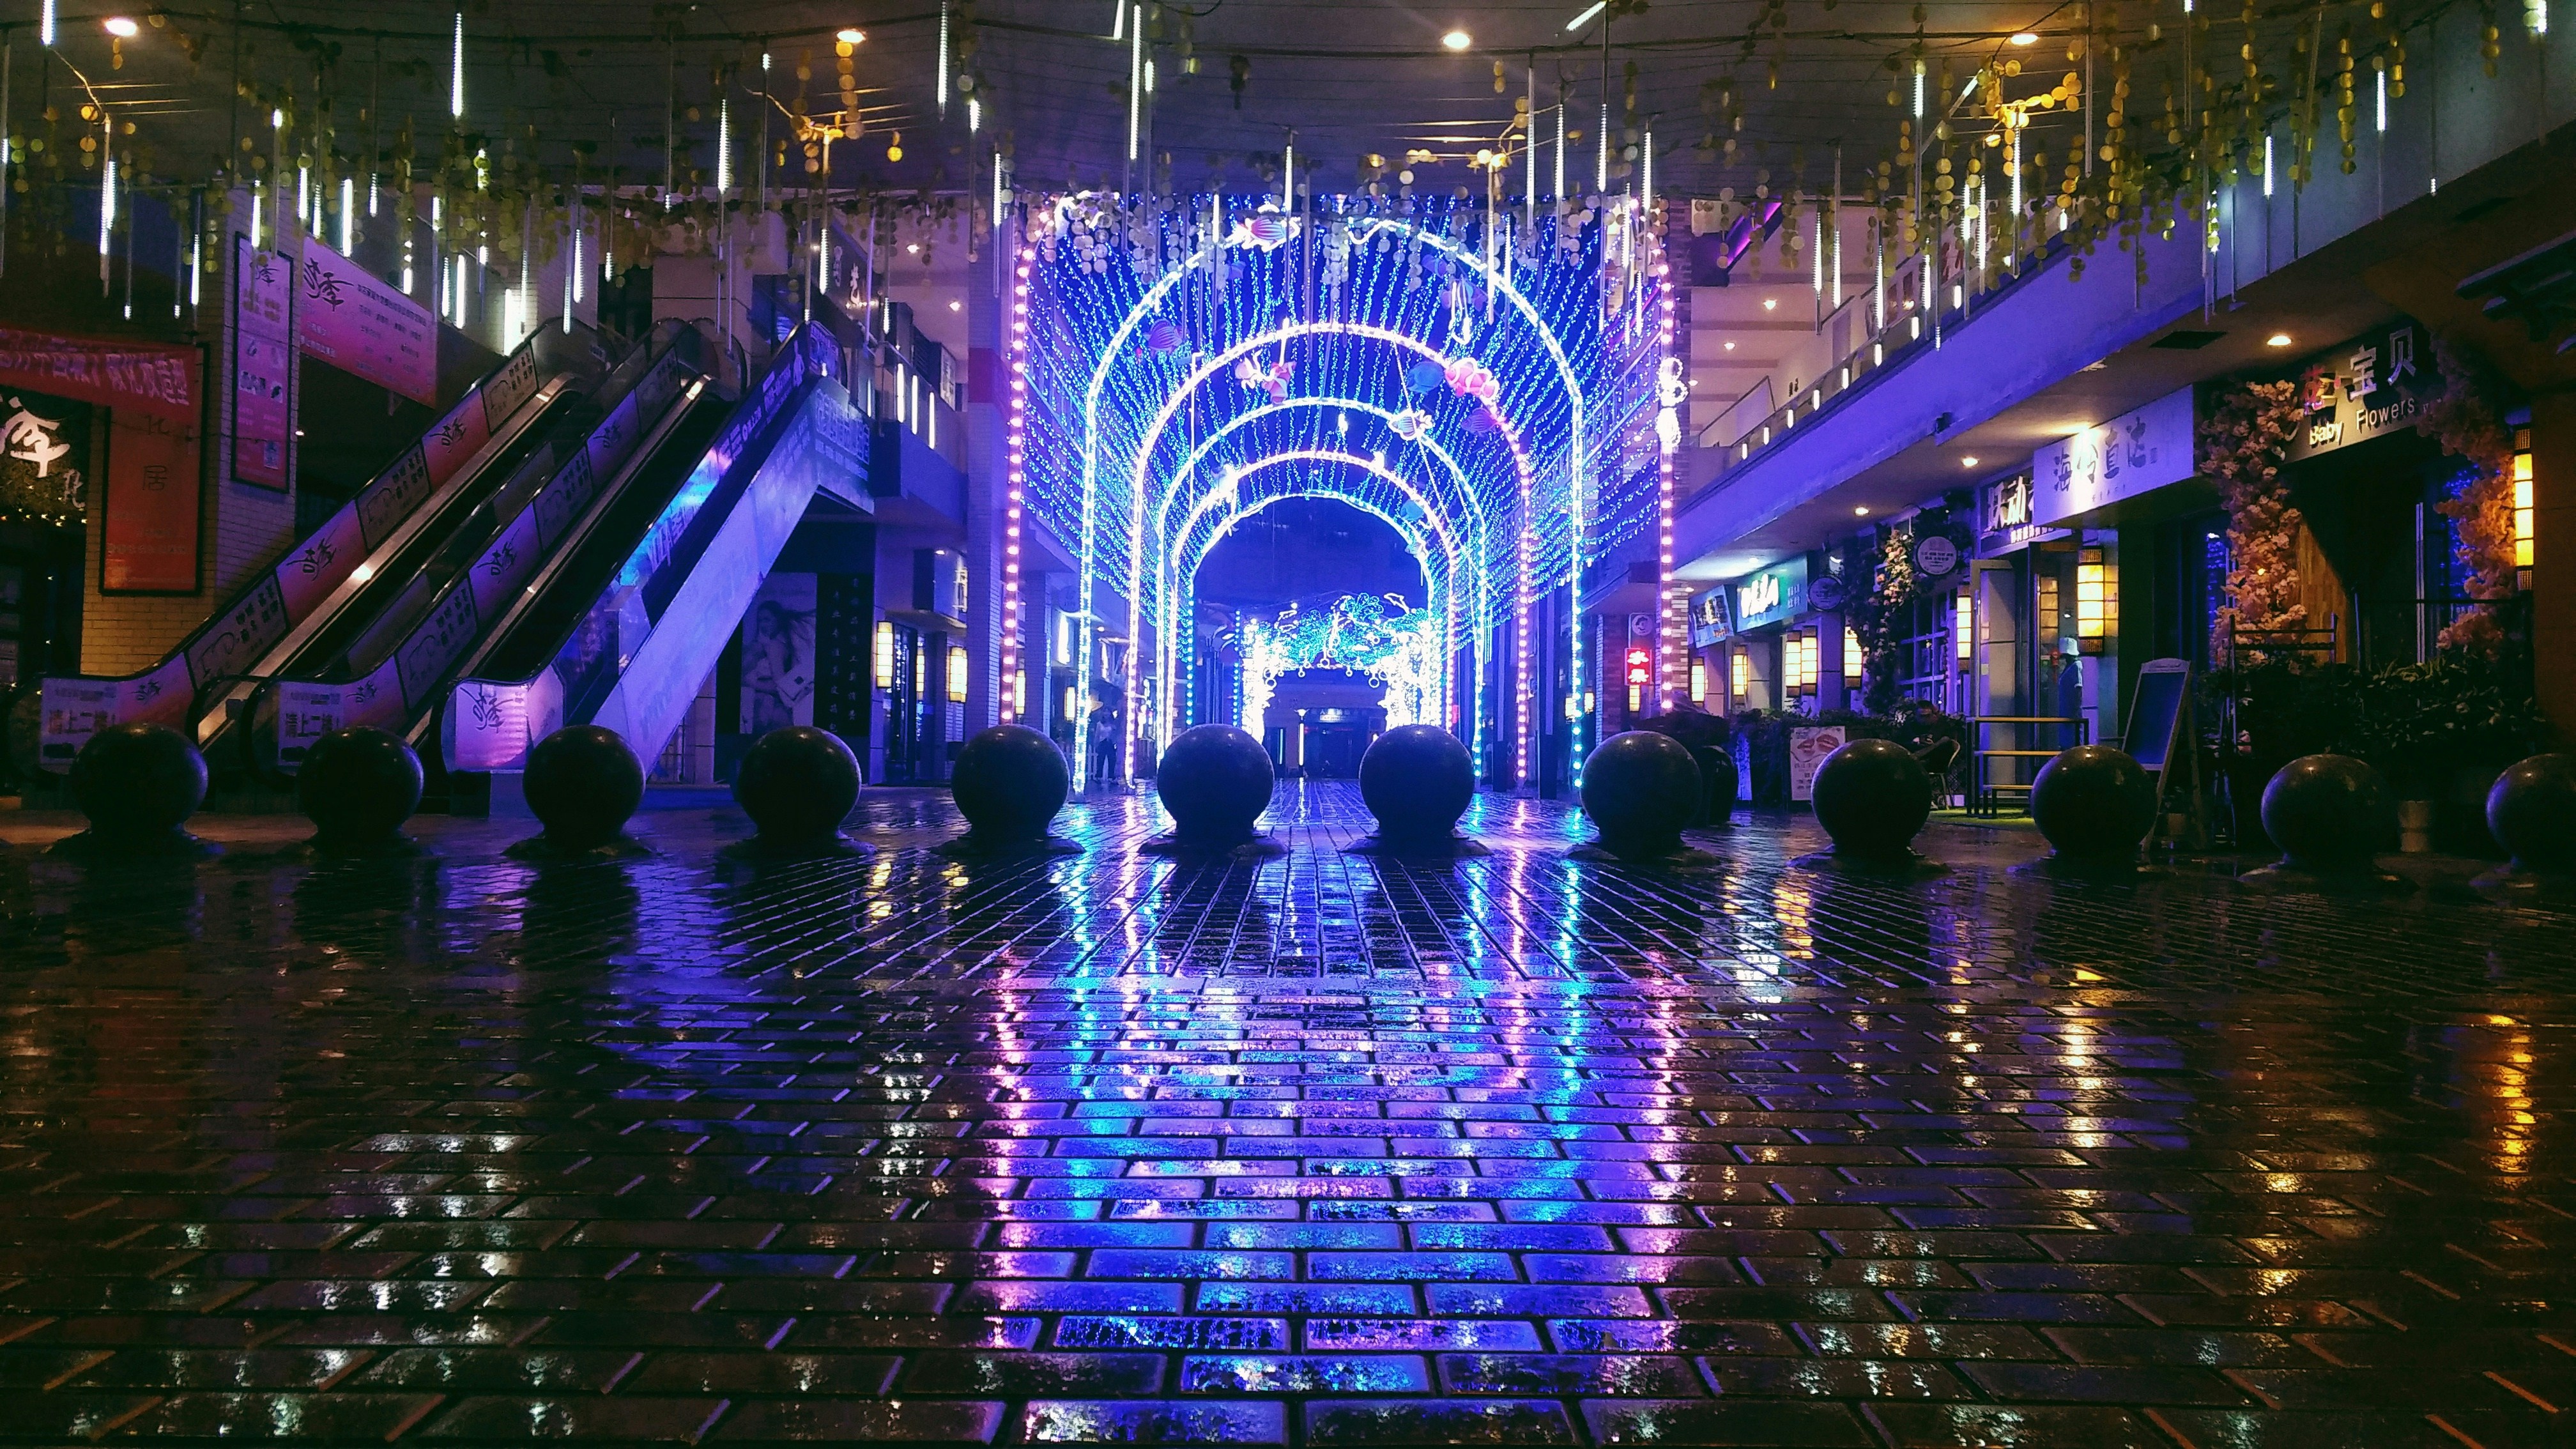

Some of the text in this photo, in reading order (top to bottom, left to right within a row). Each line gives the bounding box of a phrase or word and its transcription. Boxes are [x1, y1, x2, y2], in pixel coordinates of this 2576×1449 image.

[2310, 422, 2343, 445] Baby
[2356, 398, 2415, 430] Flowers
[1627, 650, 1650, 683] 水果
